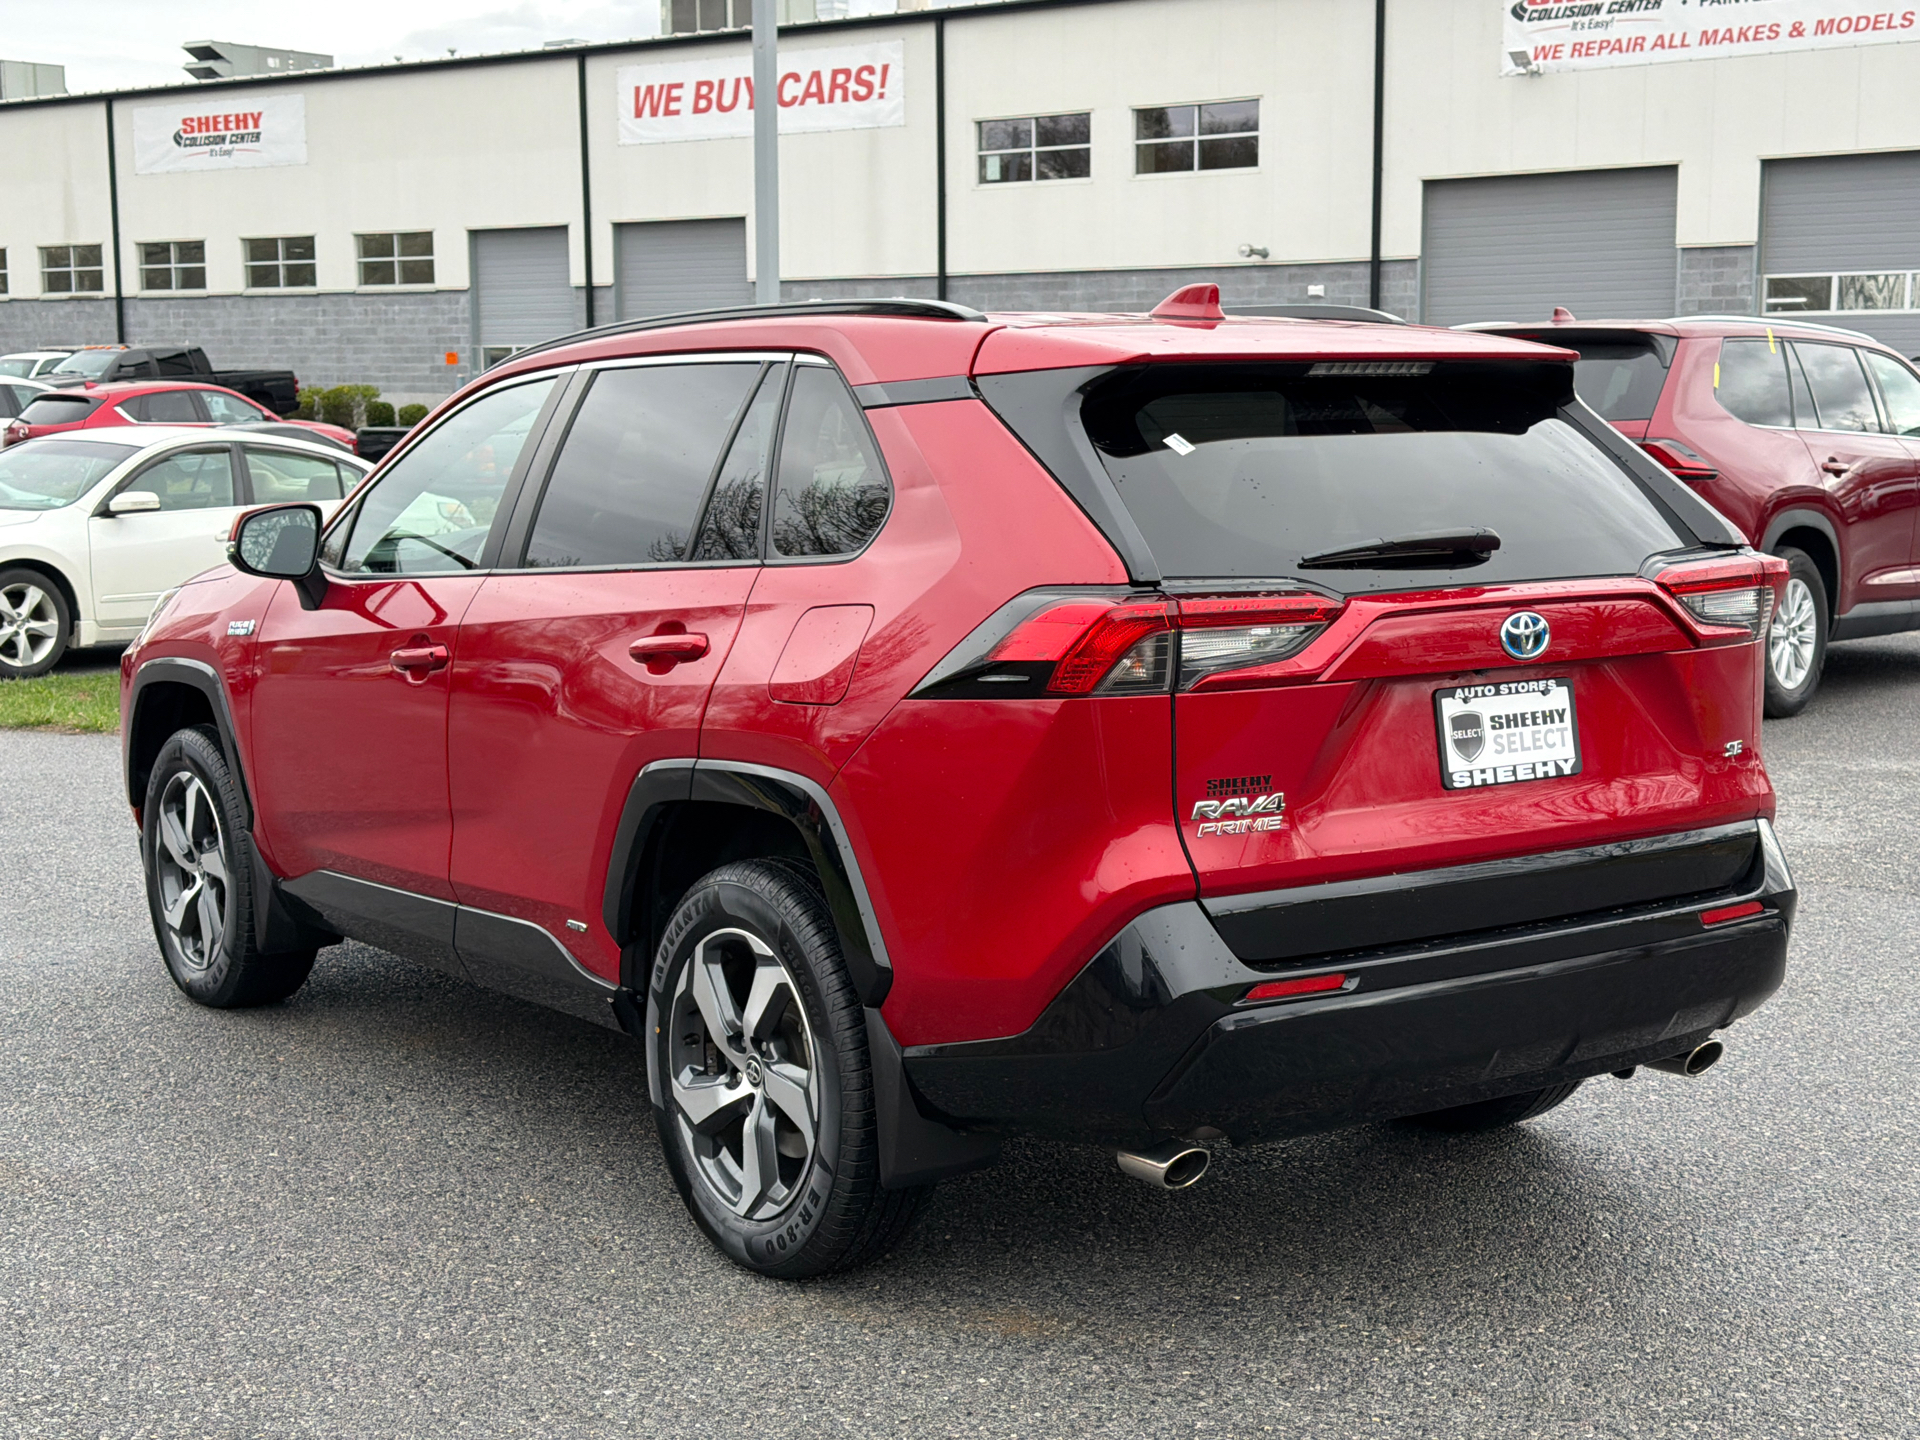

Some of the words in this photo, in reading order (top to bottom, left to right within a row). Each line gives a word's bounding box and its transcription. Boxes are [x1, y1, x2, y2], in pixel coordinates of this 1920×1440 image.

[1527, 3, 1600, 22] COLLISION
[1606, 0, 1662, 14] CENTER
[1533, 44, 1565, 61] WE
[1570, 36, 1646, 59] REPAIR
[1651, 32, 1691, 50] ALL
[1699, 23, 1781, 46] MAKES
[1788, 21, 1806, 38] &
[1814, 11, 1916, 36] MODELS
[1571, 20, 1586, 31] It's
[633, 82, 684, 119] WE
[777, 63, 890, 108] CARS!
[182, 111, 263, 134] SHEEHY
[183, 134, 227, 148] COLLISION
[229, 131, 261, 145] CENTER
[1454, 685, 1495, 698] AUTO
[1500, 679, 1557, 695] STORES
[1489, 708, 1567, 730] SHEEHY
[1452, 728, 1483, 739] SELECT
[1493, 727, 1568, 755] SELECT
[1724, 740, 1743, 757] SE
[1207, 775, 1272, 789] SHEEHY
[1452, 758, 1576, 788] SHEEHY
[1191, 792, 1286, 820] RAV4
[1197, 816, 1283, 838] PRIME
[765, 1186, 821, 1256] ER-800
